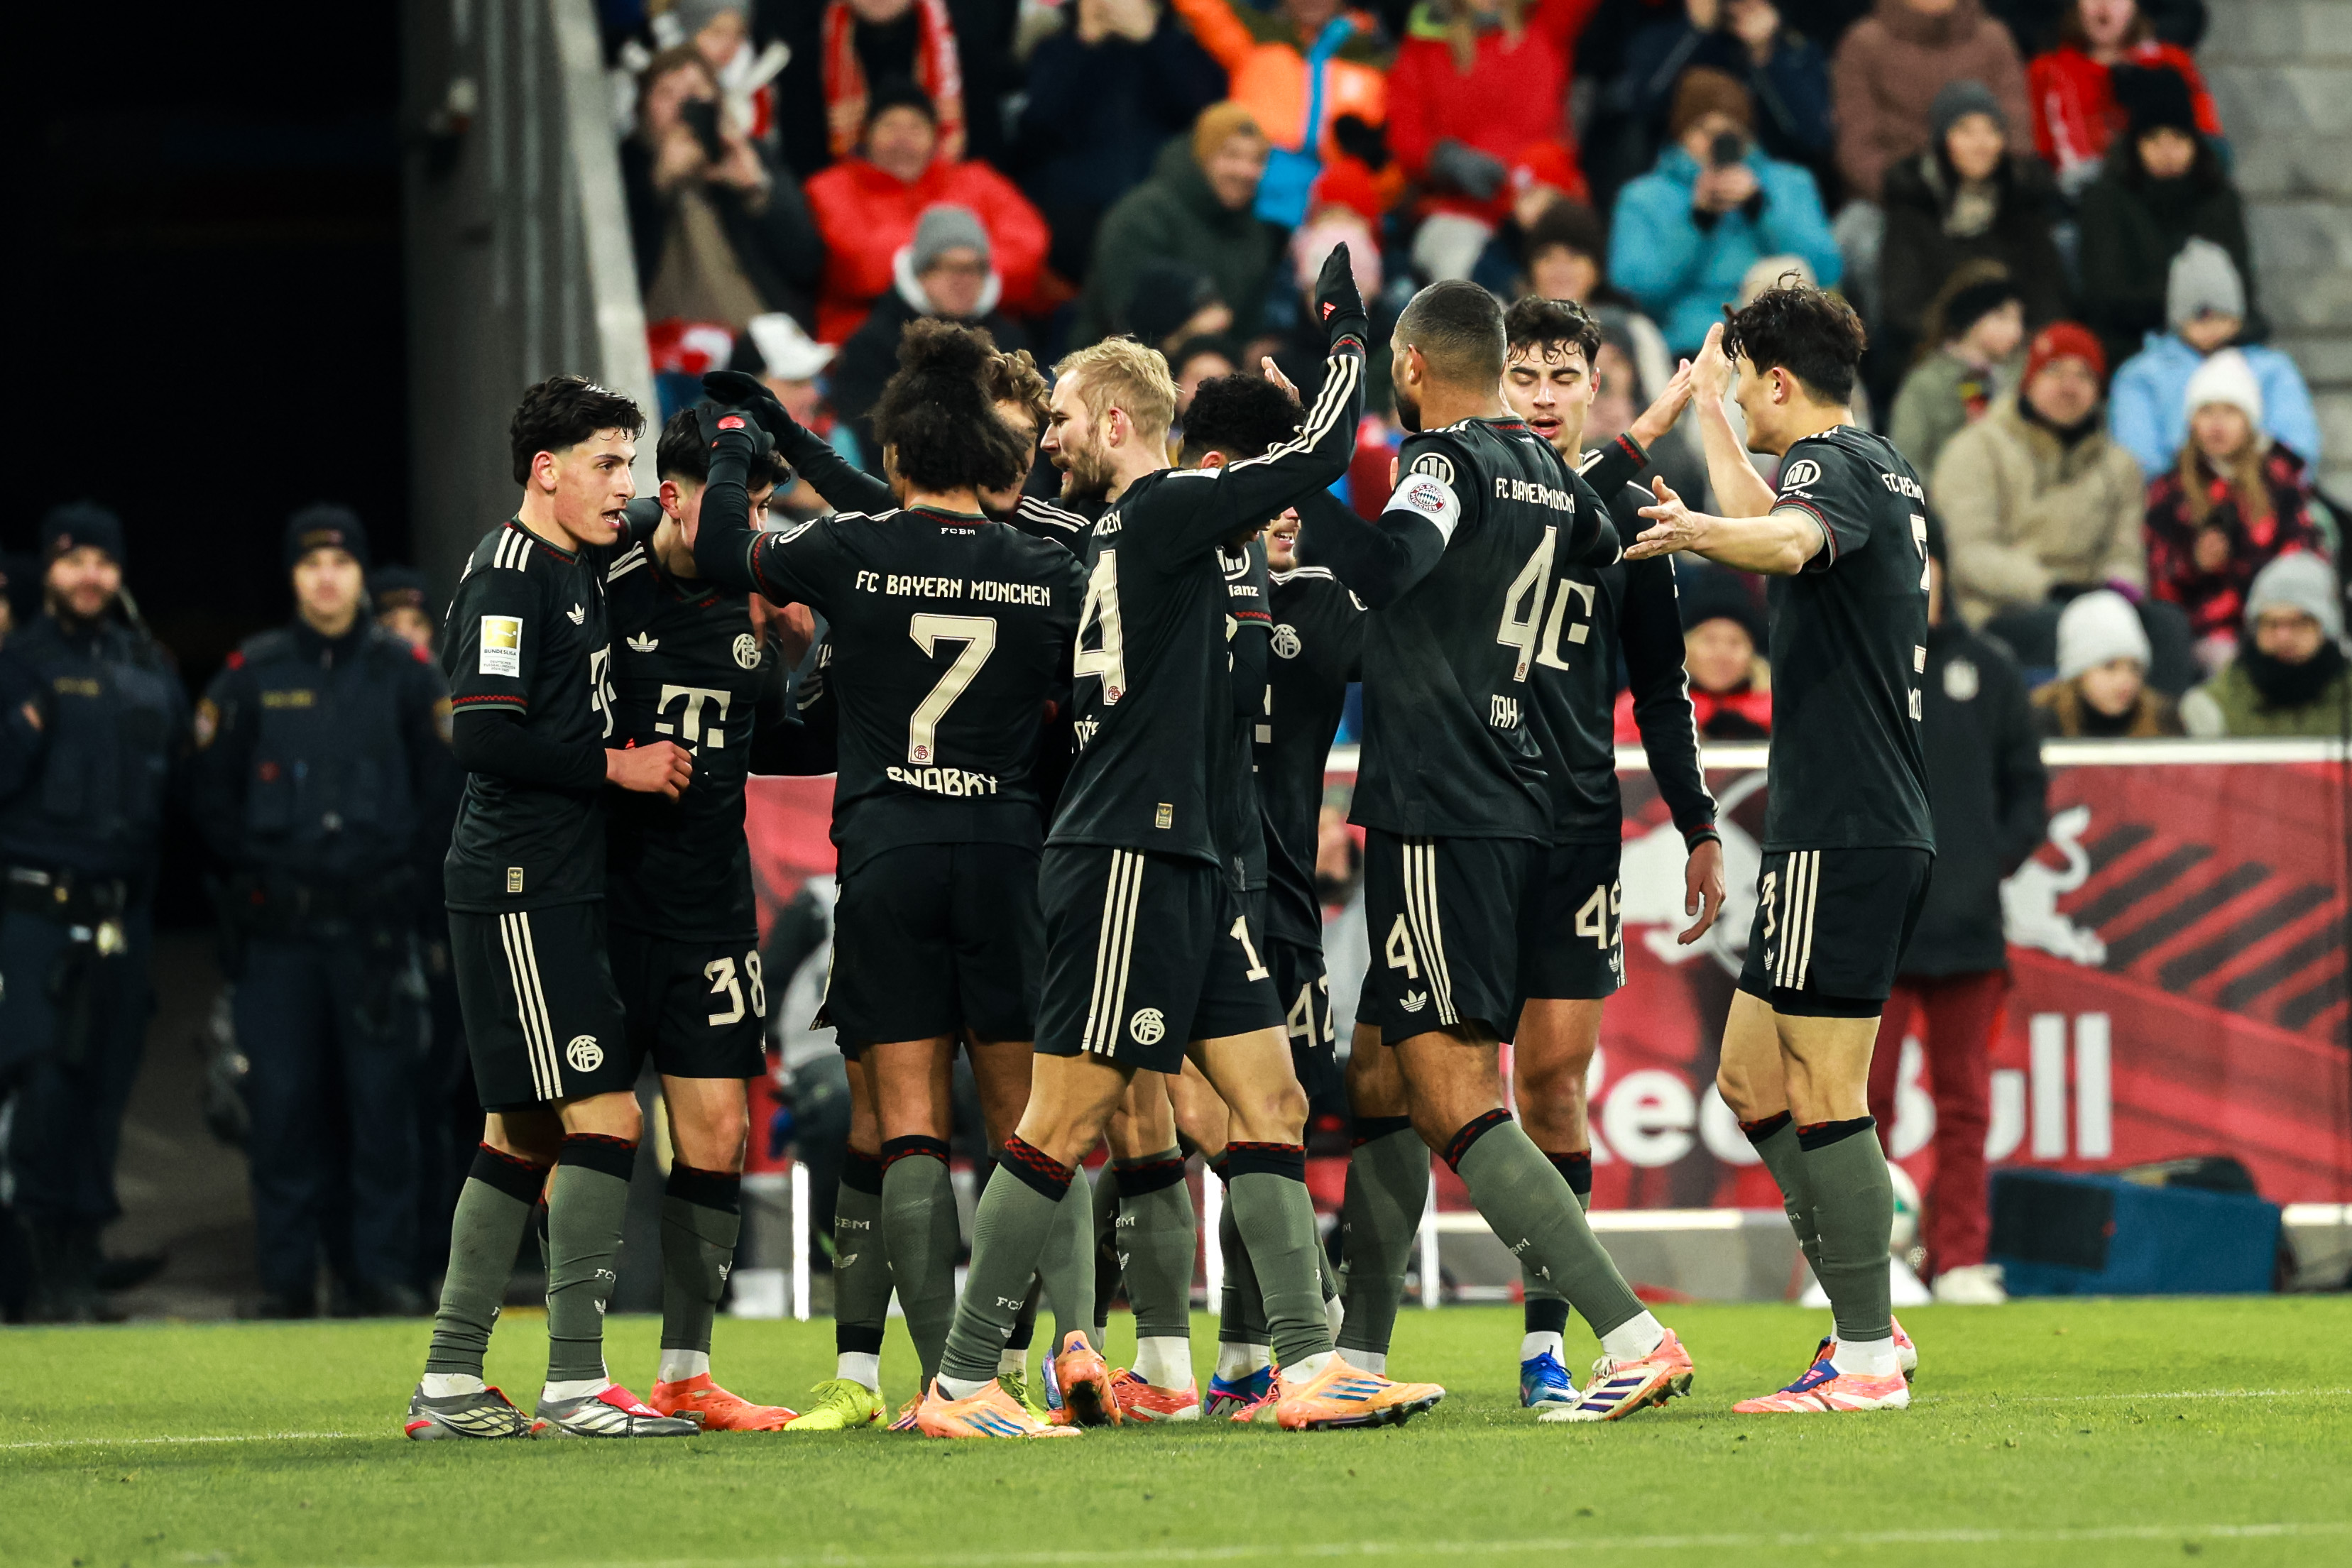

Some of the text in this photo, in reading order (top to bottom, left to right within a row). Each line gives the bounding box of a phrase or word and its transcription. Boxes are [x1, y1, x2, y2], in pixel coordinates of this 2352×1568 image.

[1495, 477, 1509, 498] FC
[855, 570, 1051, 607] FC BAYERN MÜNCHEN
[1228, 583, 1259, 598] ianz
[1497, 525, 1558, 683] 4
[908, 612, 997, 765] 7
[1489, 693, 1518, 730] TAH
[1385, 912, 1419, 980] 4
[704, 949, 766, 1026] 38
